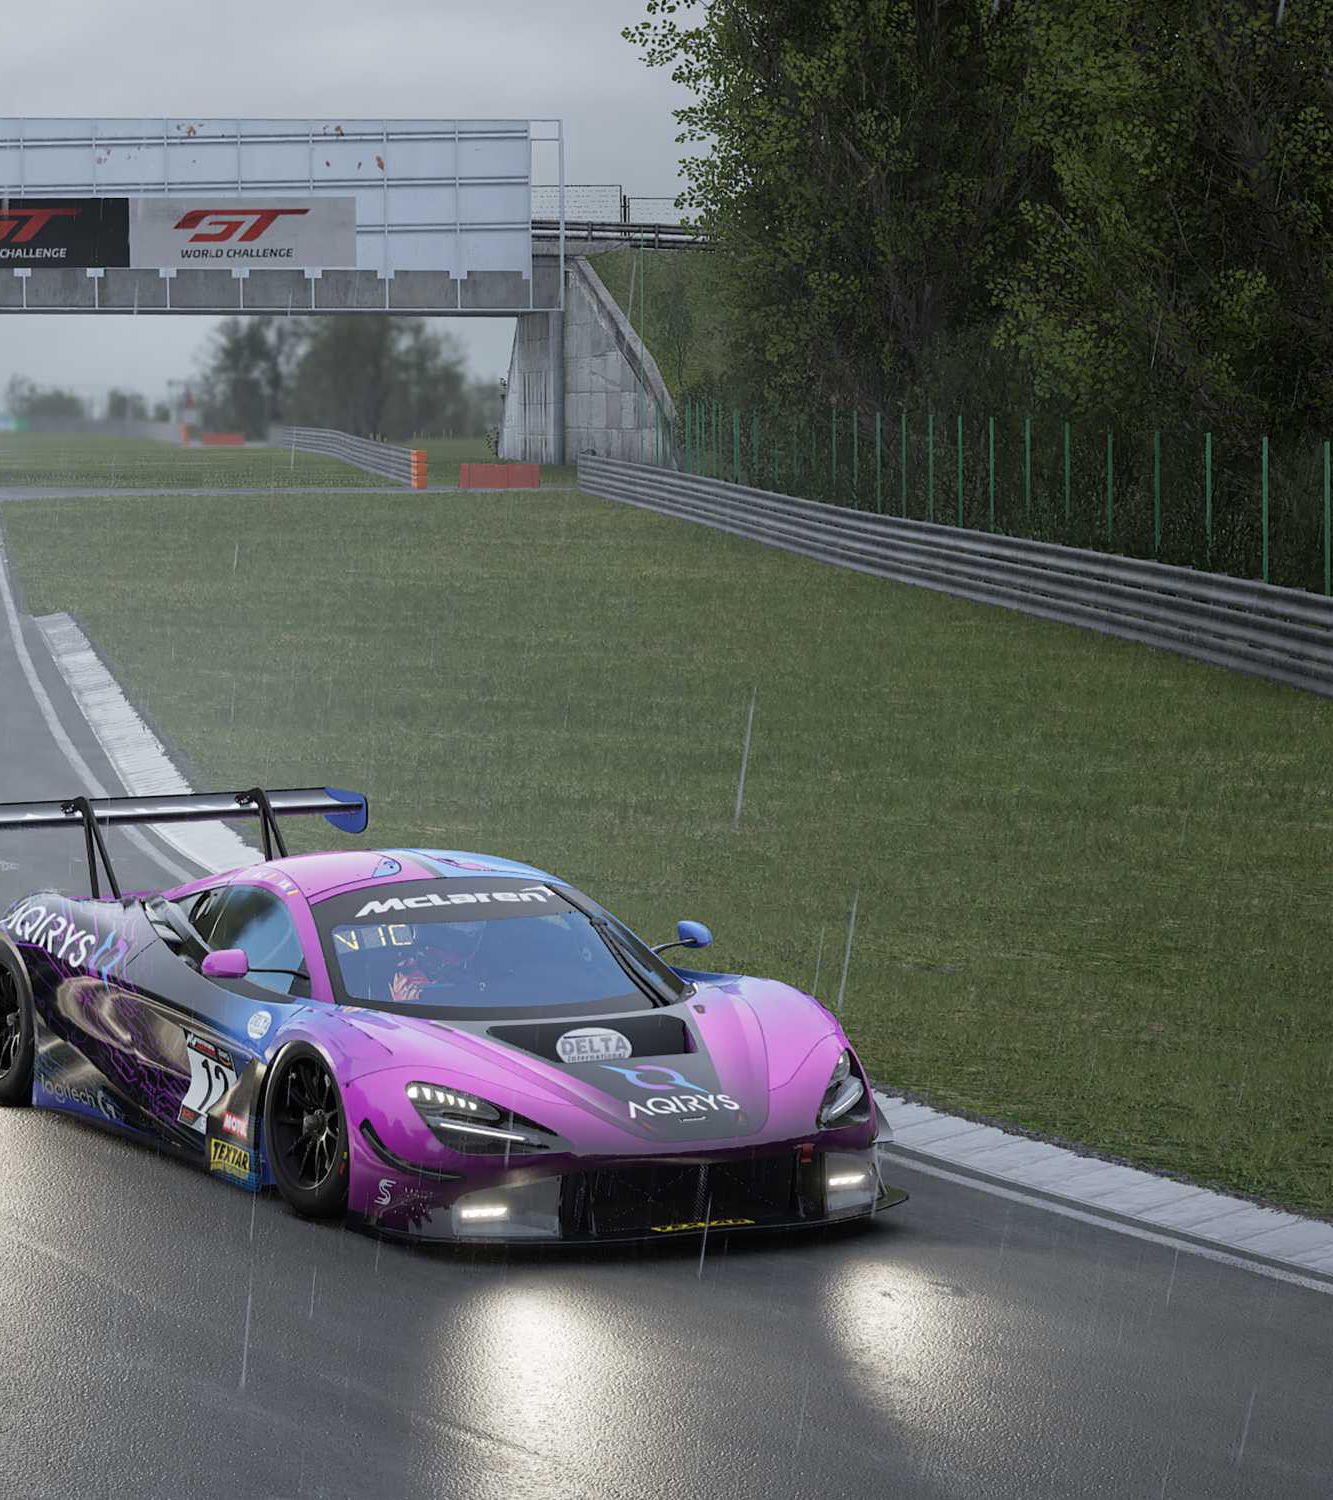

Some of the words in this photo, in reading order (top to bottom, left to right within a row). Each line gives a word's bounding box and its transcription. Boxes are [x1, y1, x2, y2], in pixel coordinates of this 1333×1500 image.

[0, 248, 67, 258] CHALLENGE
[180, 248, 223, 258] WORLD
[226, 248, 294, 258] CHALLENGE
[355, 891, 549, 918] McLaren
[560, 1036, 628, 1055] DELTA
[41, 1073, 96, 1108] logitech
[627, 1094, 740, 1119] AQIRYS
[212, 1139, 249, 1170] TEXTAR
